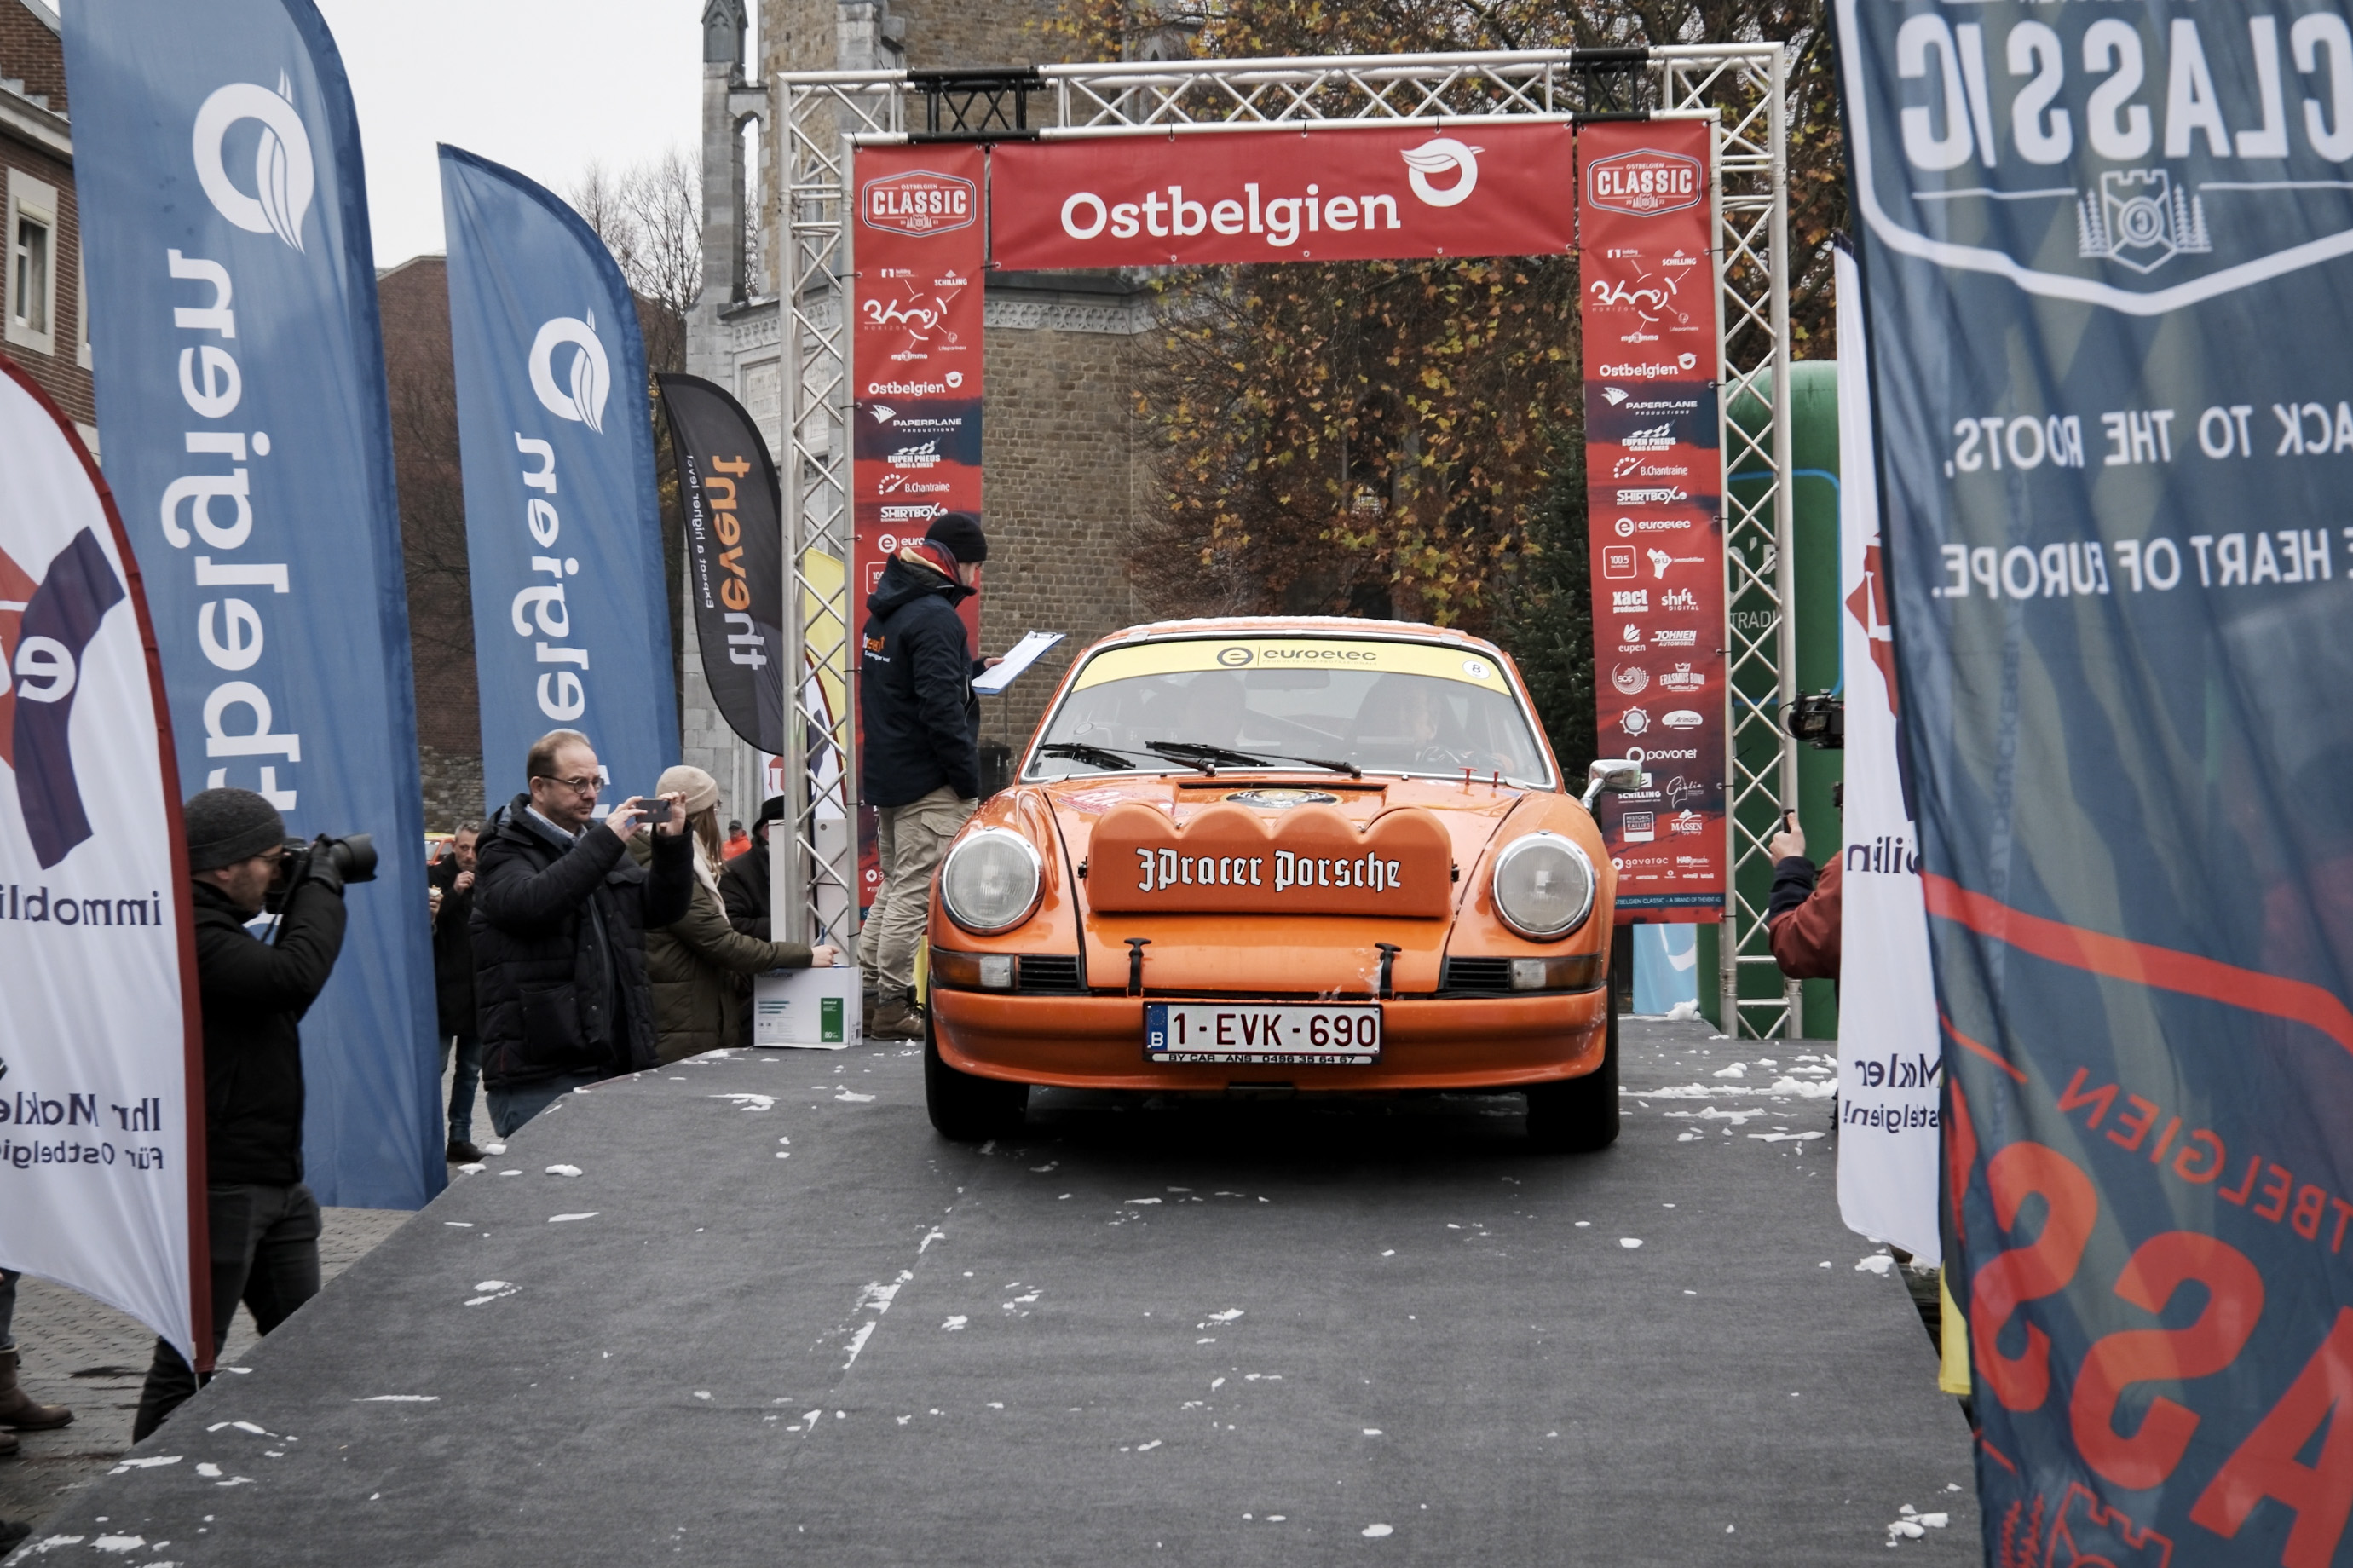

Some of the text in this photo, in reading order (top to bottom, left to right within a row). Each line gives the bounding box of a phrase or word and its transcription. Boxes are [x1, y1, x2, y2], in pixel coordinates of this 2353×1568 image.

[1597, 170, 1692, 194] CLASSIC
[873, 190, 966, 215] CLASSIC
[1061, 182, 1400, 246] Ostbelgien
[1662, 257, 1697, 266] SCHILLING
[934, 278, 967, 286] SCHILLING
[1600, 363, 1678, 378] Ostbelgien
[868, 382, 945, 396] Ostbelgien
[1626, 401, 1698, 409] PAPERPLANE
[1622, 436, 1676, 447] EUPEN PNEUS
[914, 454, 940, 463] PNEUS
[1641, 466, 1687, 476] B.Chantraine
[905, 481, 949, 493] B.Chantraine
[1638, 520, 1691, 530] euroelec
[1610, 555, 1629, 565] 100,5
[1612, 589, 1648, 606] xact
[1613, 605, 1648, 614] production
[1730, 610, 1776, 629] TRADI
[1651, 630, 1697, 642] JOHNEN
[1618, 643, 1646, 654] eupen
[1264, 649, 1376, 660] euroelec
[1660, 673, 1688, 686] ERASMUS
[1647, 749, 1697, 761] pavonet
[1618, 791, 1661, 799] SCHILLING
[1671, 822, 1702, 831] MASSEN
[1274, 850, 1402, 892] Porsche
[1174, 1012, 1376, 1047] 1-EVK-690
[1151, 1032, 1164, 1046] B
[1190, 1054, 1215, 1063] CAR
[1299, 1055, 1315, 1064] 35
[1319, 1056, 1335, 1064] 64
[1339, 1056, 1356, 1064] 67
